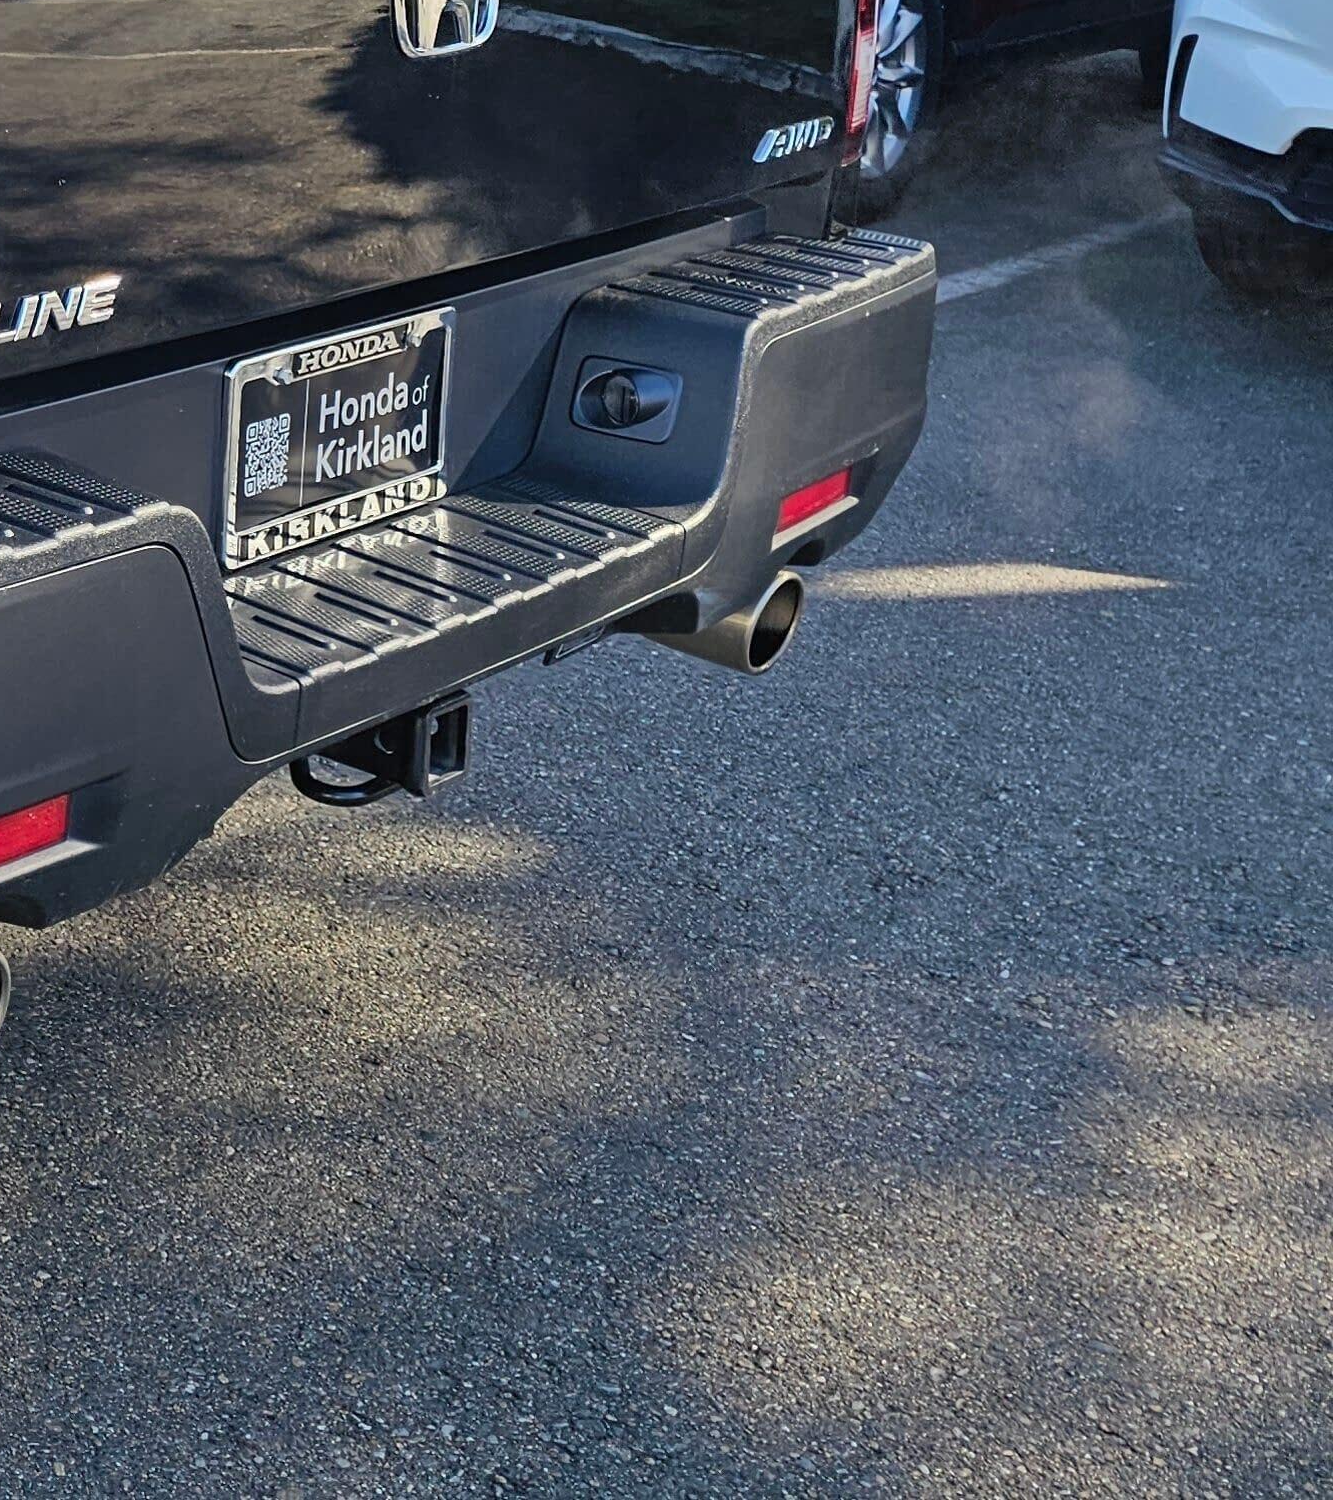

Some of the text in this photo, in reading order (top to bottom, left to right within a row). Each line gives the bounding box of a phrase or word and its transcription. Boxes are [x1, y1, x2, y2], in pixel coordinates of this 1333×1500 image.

[754, 116, 834, 161] AWD
[297, 330, 400, 374] HONDA
[318, 372, 430, 433] Honda of
[315, 409, 428, 482] Kirkland
[248, 477, 431, 560] KIRKLAND
